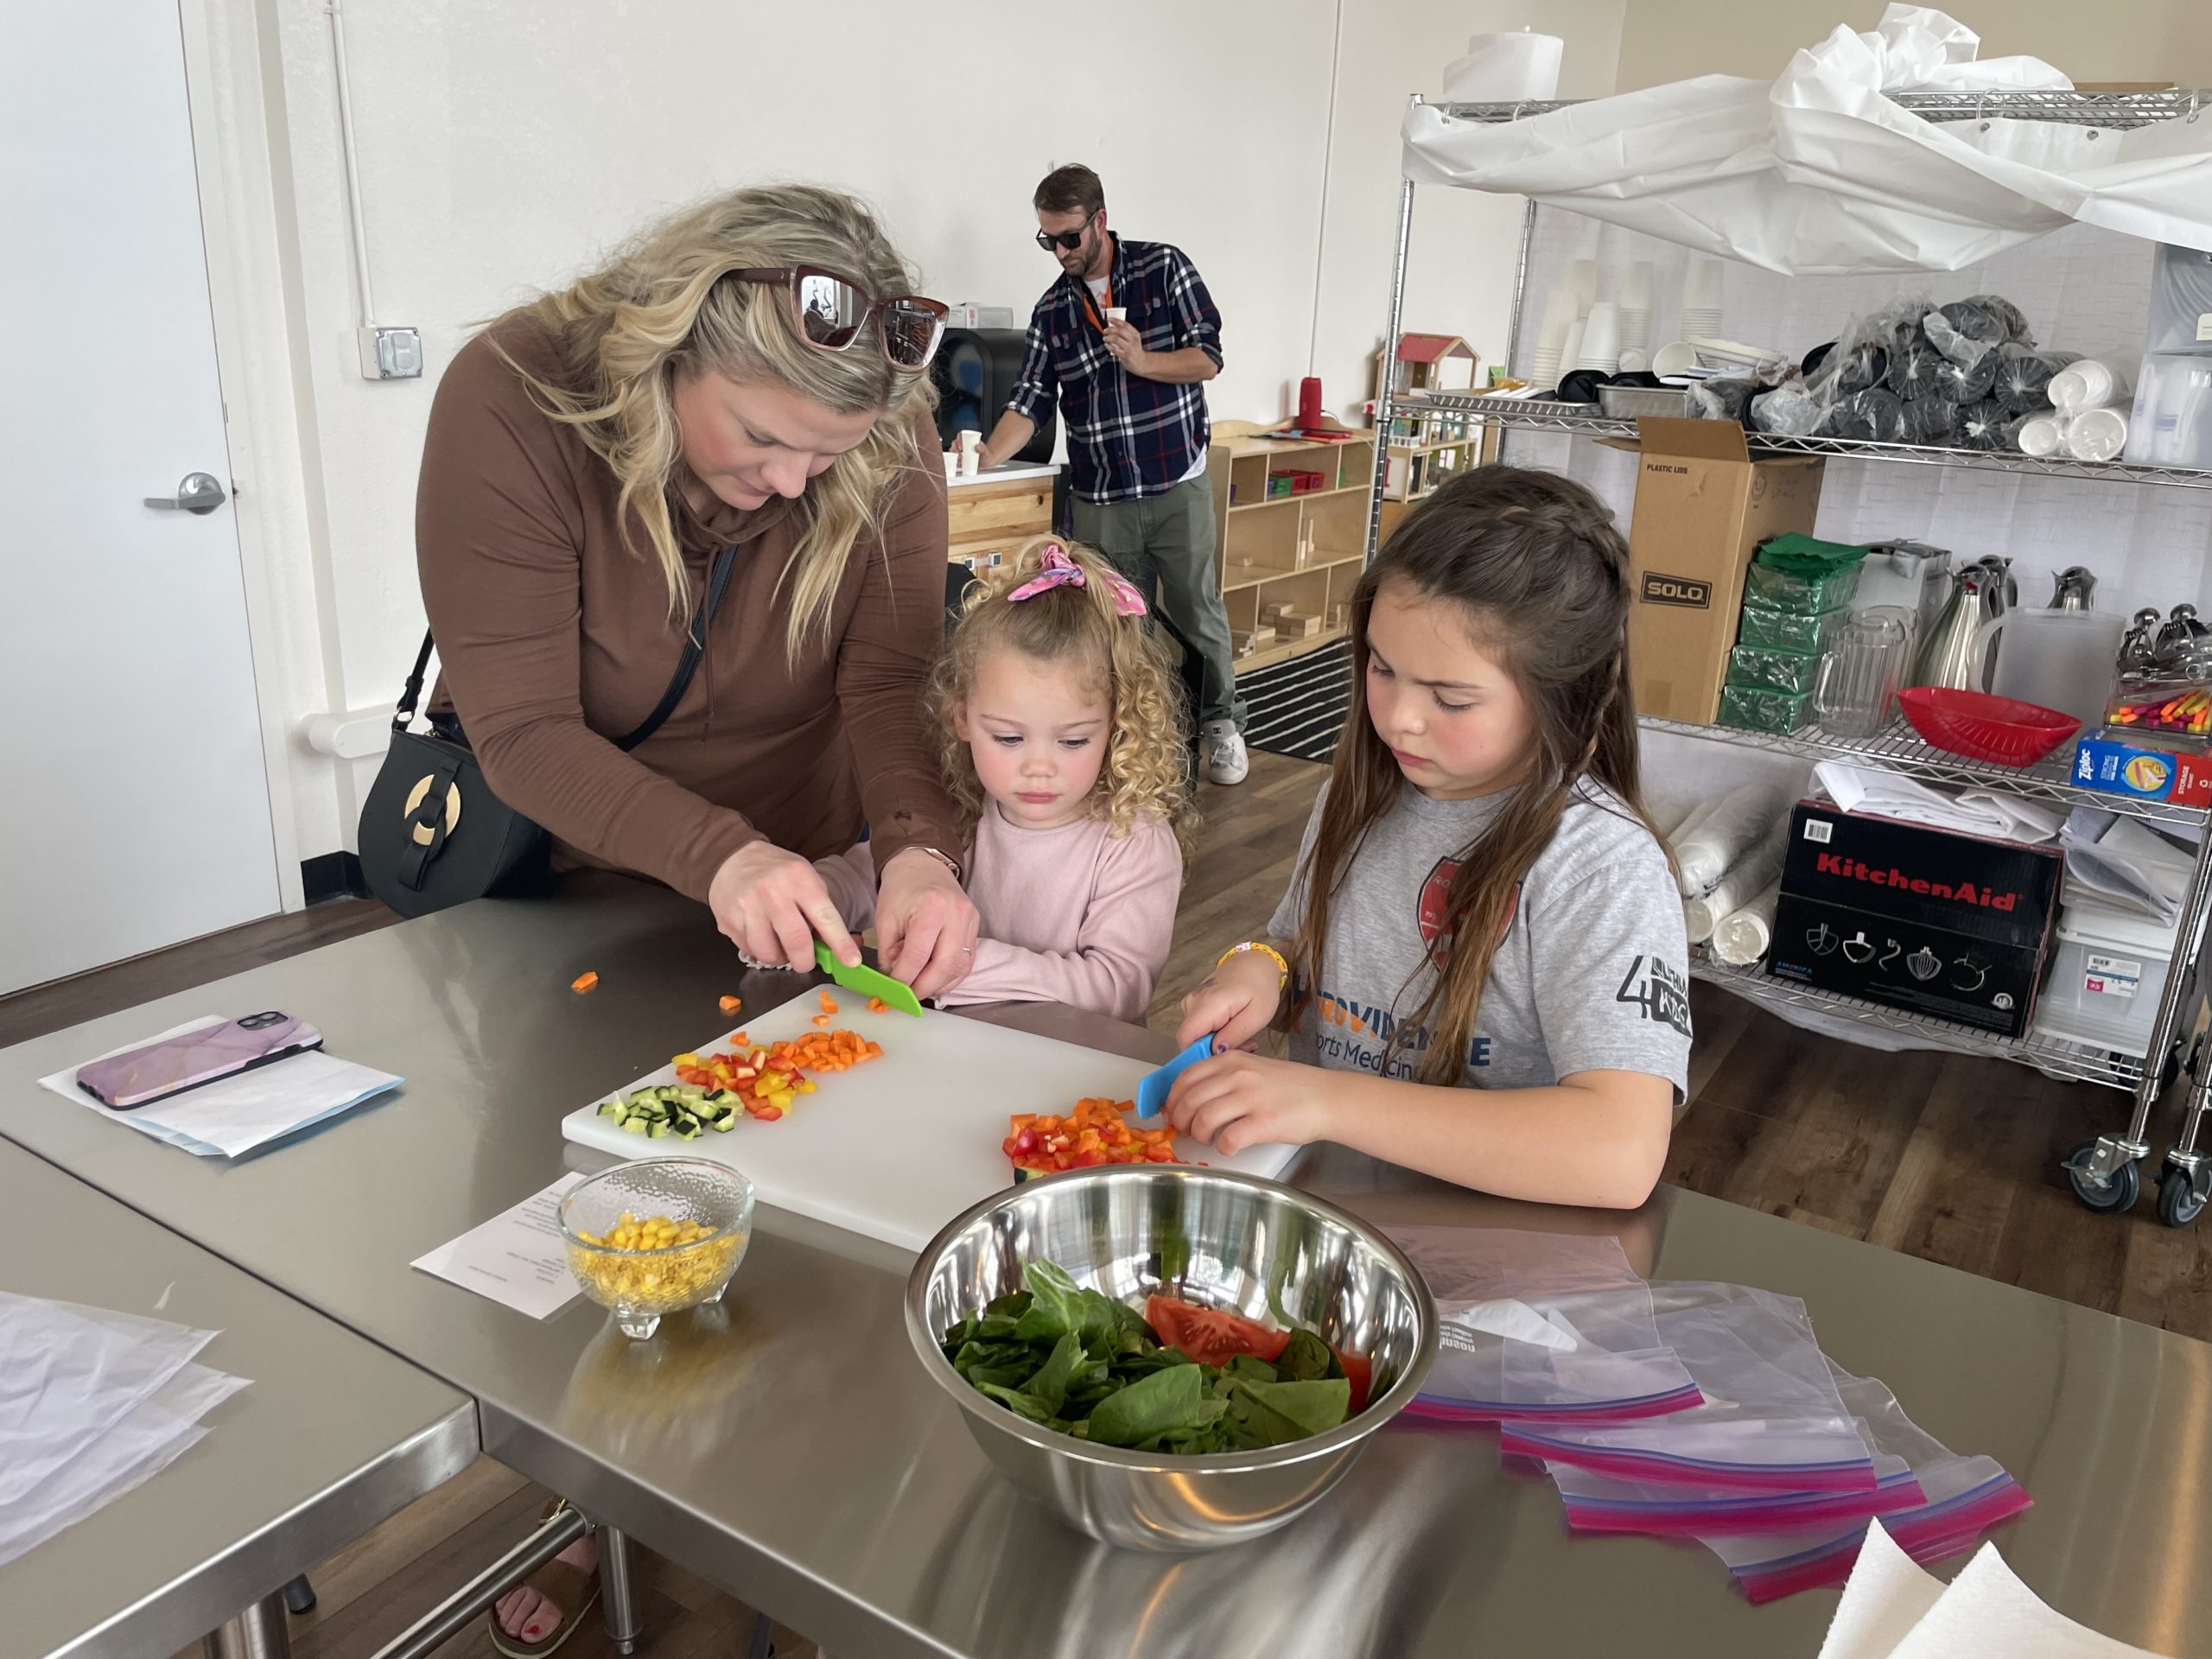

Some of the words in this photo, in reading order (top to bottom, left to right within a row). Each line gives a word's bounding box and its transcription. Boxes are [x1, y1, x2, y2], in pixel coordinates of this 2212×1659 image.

[1647, 464, 1673, 474] PLASTIC
[1648, 582, 1704, 601] SOLO
[2078, 748, 2094, 781] Ziploc
[2177, 766, 2190, 795] STORAGE
[1816, 851, 2017, 912] KitchenAid
[1776, 960, 1814, 976] AMERICA
